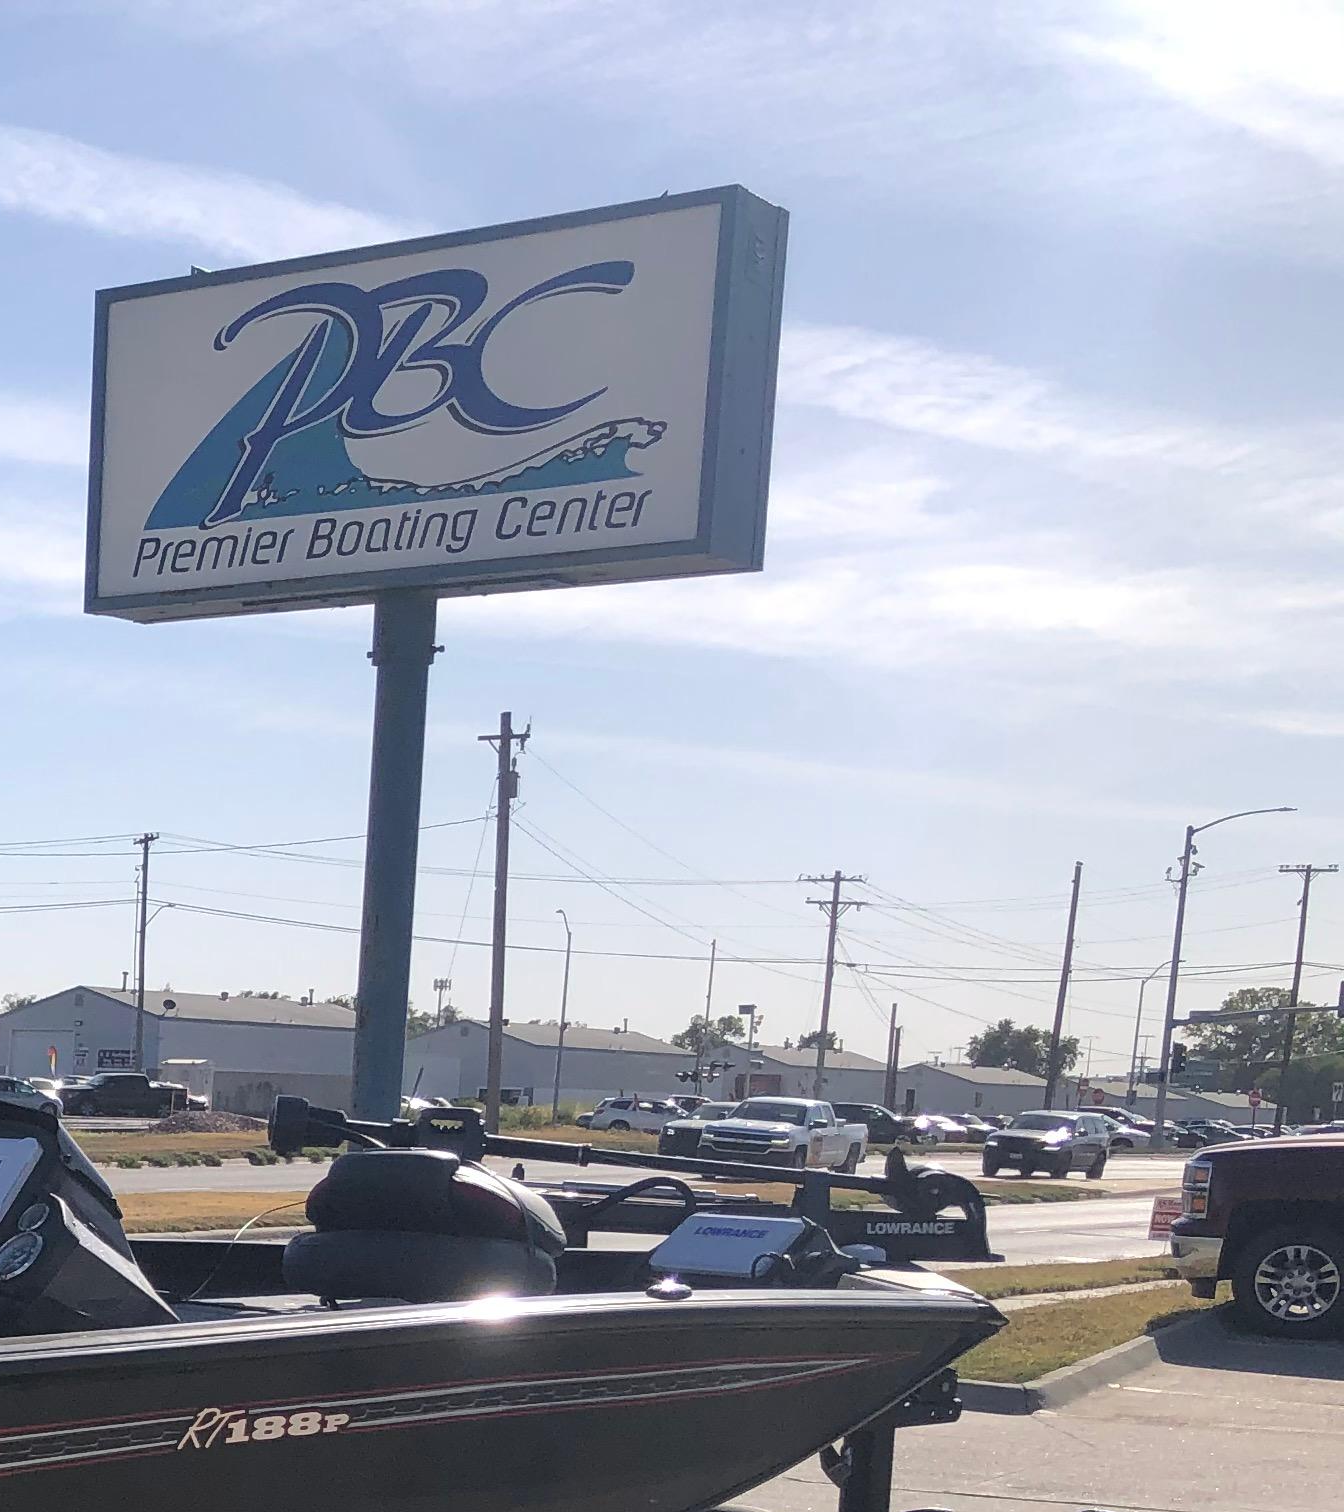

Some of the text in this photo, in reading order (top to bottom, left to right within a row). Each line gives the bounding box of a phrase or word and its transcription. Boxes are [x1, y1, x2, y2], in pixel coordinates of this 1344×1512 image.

[200, 259, 635, 530] PBC
[132, 487, 654, 578] Premier Boating Center
[694, 1226, 769, 1239] LOWRANCE
[866, 1222, 955, 1235] LOWRANCE
